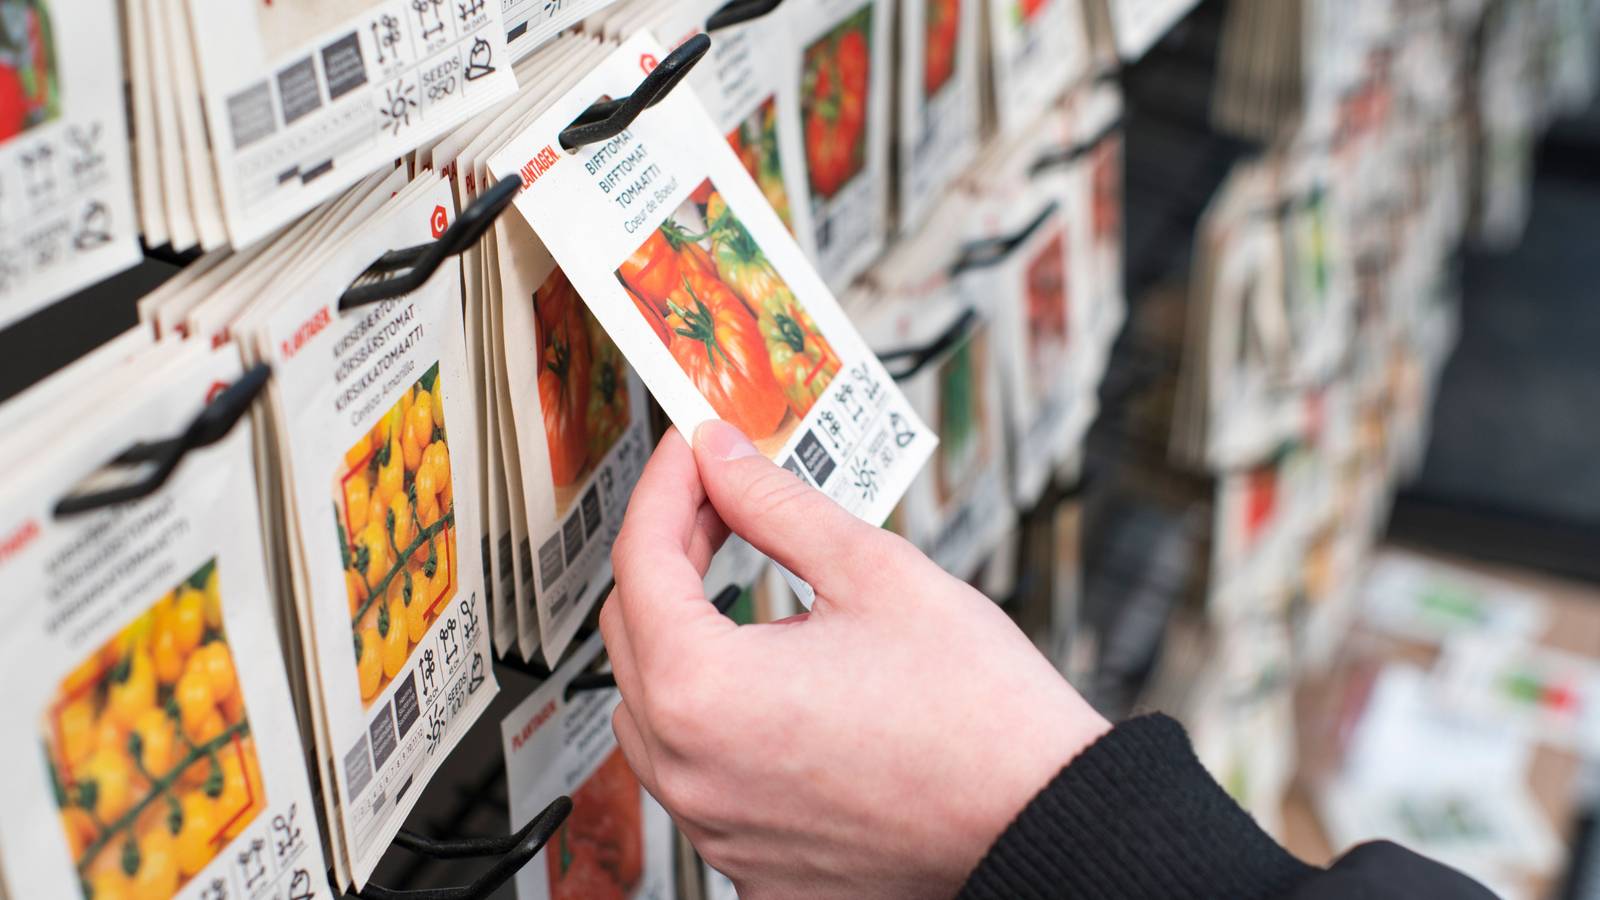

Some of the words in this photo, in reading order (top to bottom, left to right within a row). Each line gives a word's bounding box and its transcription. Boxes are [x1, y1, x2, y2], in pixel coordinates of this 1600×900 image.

[423, 56, 460, 86] SEEDS
[518, 145, 559, 194] LANTAGEN
[598, 143, 649, 194] BIFFTOMAT
[616, 163, 661, 208] TOMAATTI
[624, 208, 647, 234] Coeur
[646, 199, 657, 213] de
[334, 324, 424, 412] KIRSIKKATOMAATTI
[447, 672, 467, 705] SEEDS
[451, 691, 465, 718] 100
